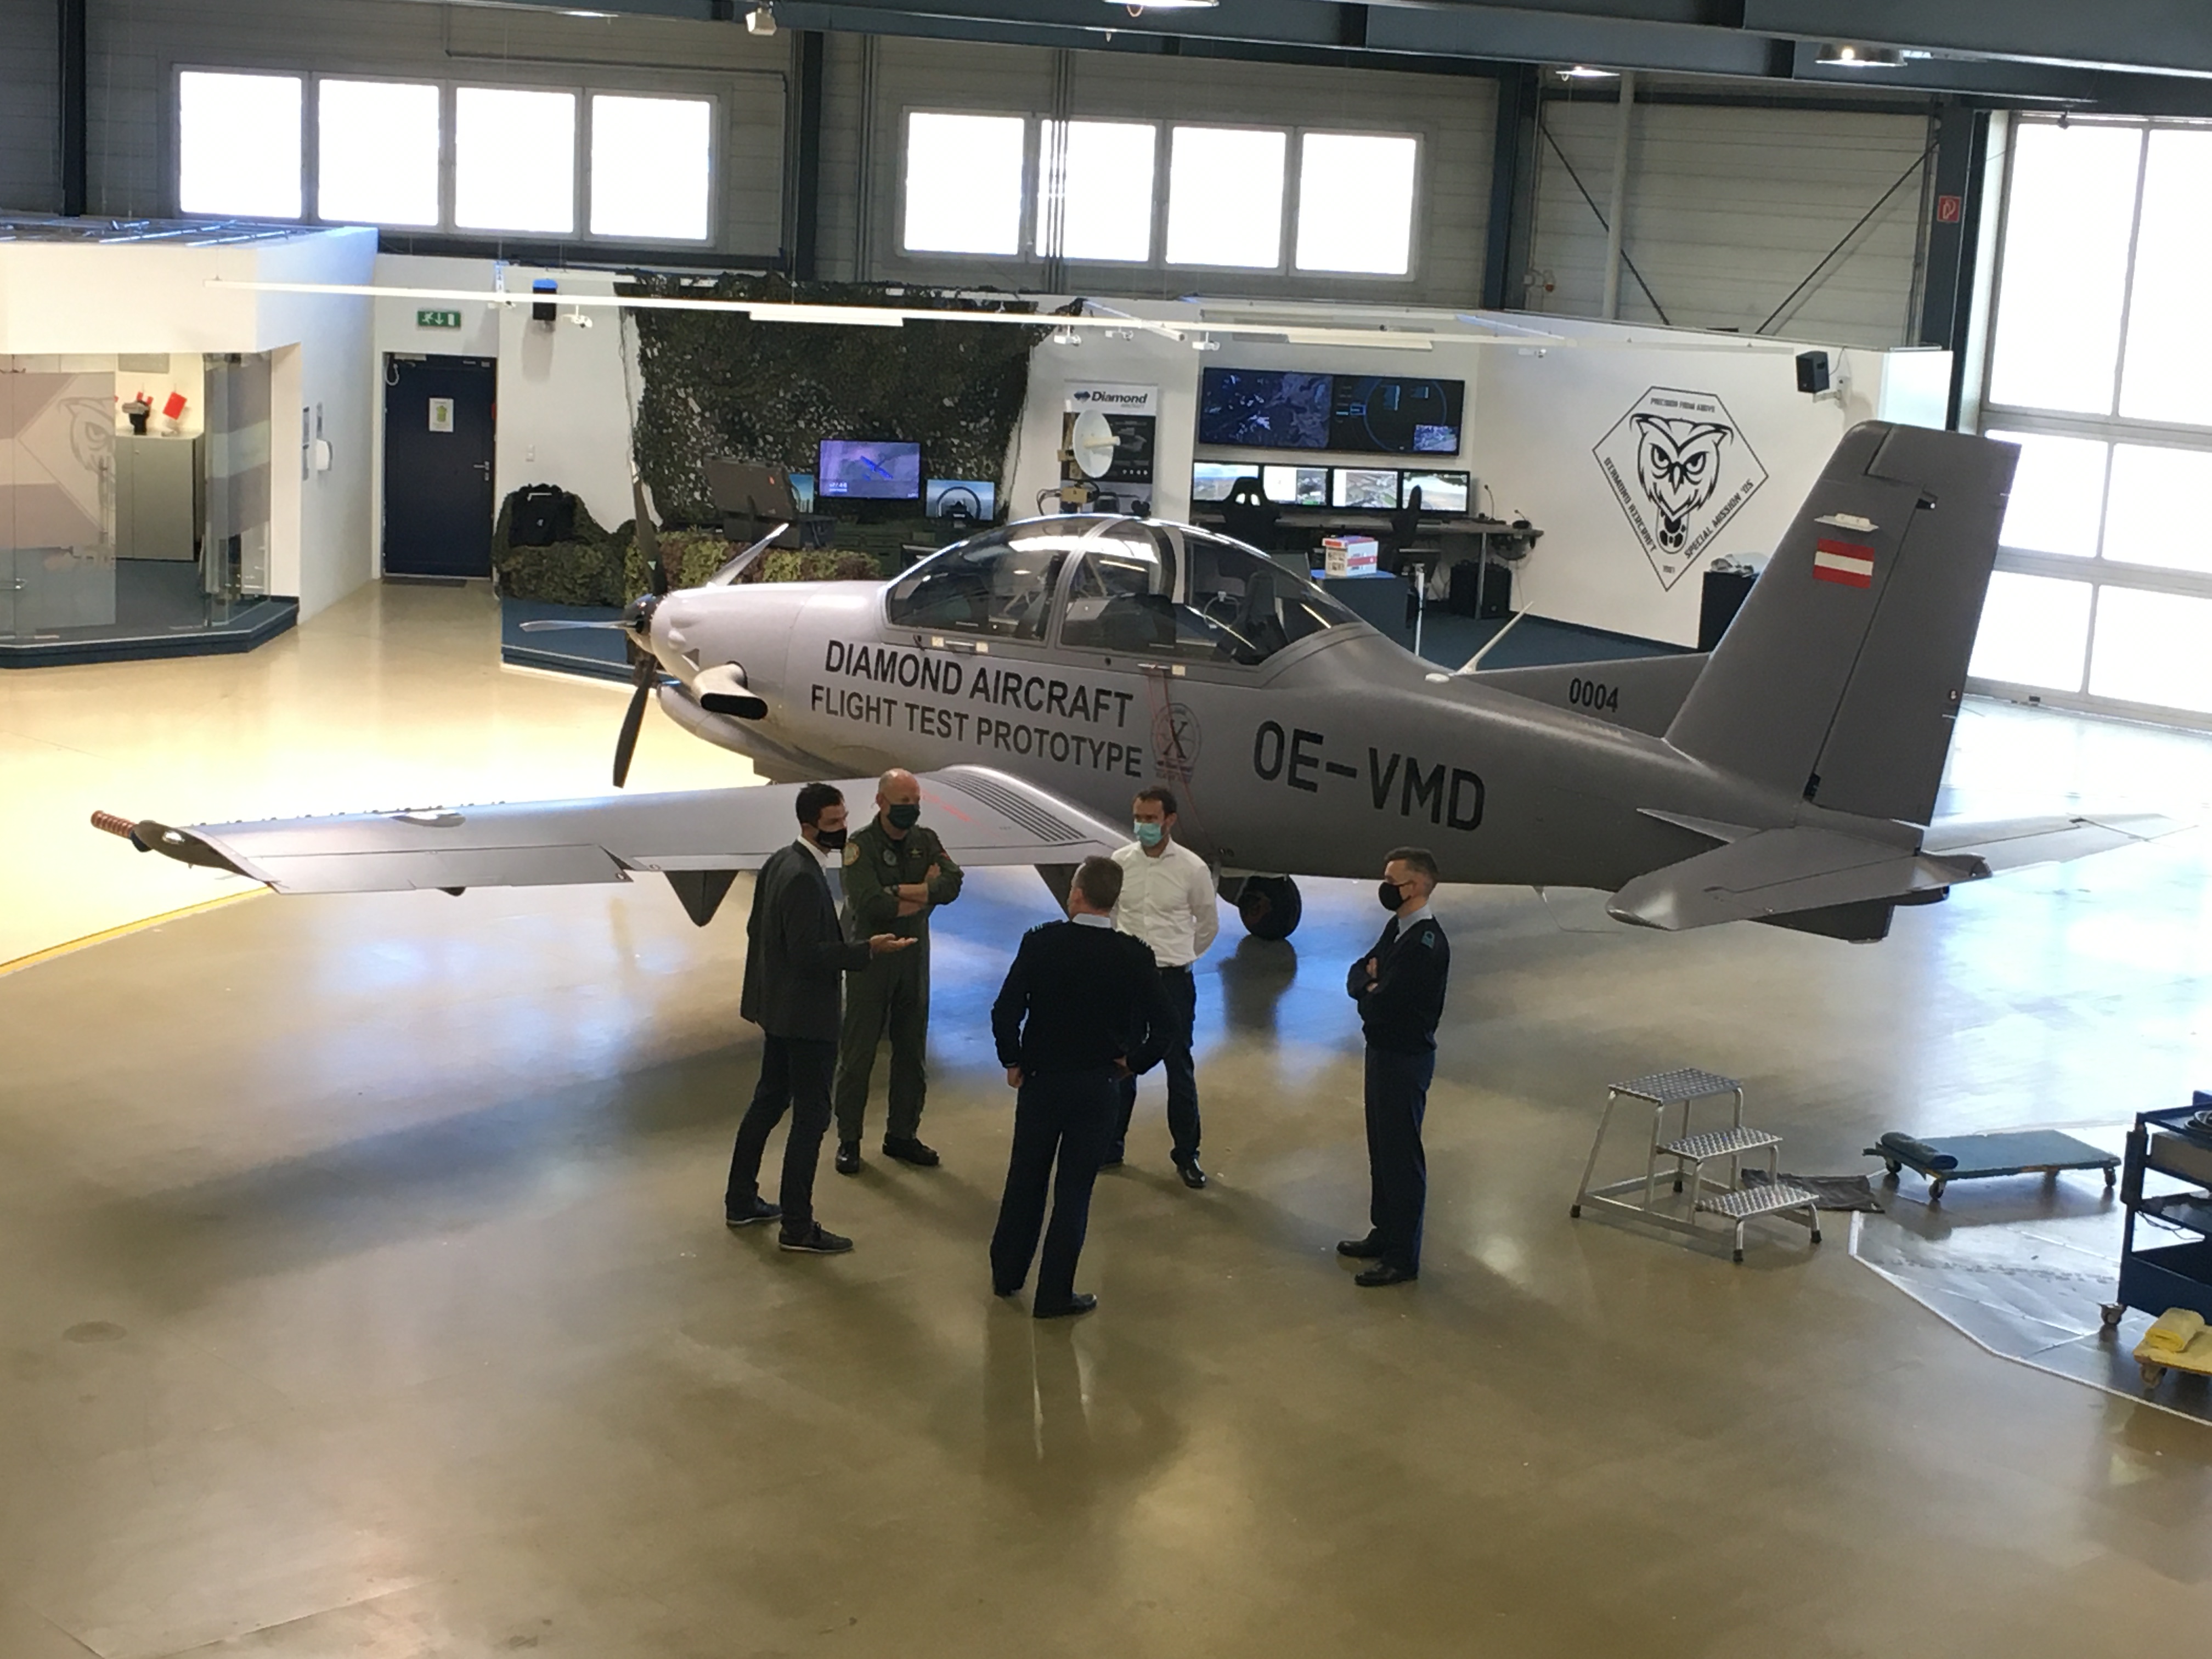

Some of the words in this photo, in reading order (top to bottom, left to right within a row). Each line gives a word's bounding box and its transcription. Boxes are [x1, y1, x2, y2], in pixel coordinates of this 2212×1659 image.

[1092, 391, 1148, 404] Diamond
[1604, 457, 1632, 504] DIAMOND
[1628, 501, 1657, 552] AIRCRAFT
[1684, 527, 1713, 559] SPECIAL
[1712, 493, 1742, 528] MISSION
[825, 639, 963, 696] DIAMOND
[968, 666, 1134, 728] AIRCRAFT
[1569, 677, 1618, 713] 0004
[810, 684, 898, 727] FLIGHT
[904, 702, 969, 741] TEST
[976, 716, 1143, 778] PROTOTYPE
[1254, 720, 1485, 832] OE-VMD
